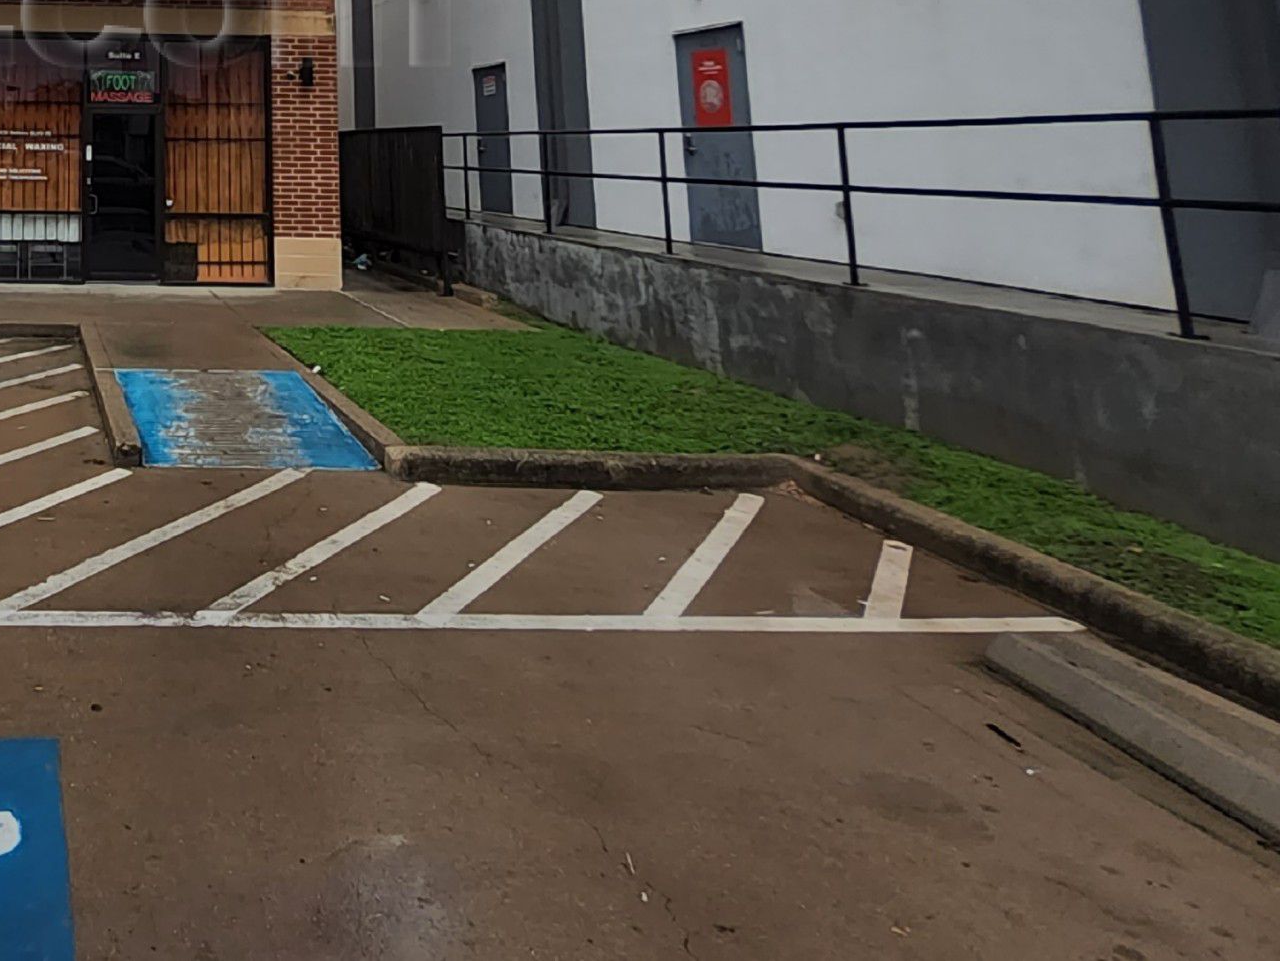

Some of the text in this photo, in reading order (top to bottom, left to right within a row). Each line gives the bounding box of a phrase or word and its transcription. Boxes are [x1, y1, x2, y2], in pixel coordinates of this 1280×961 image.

[134, 51, 141, 60] E
[106, 74, 137, 91] FOOT
[91, 91, 153, 104] MASSAGE
[25, 143, 64, 151] WAXING
